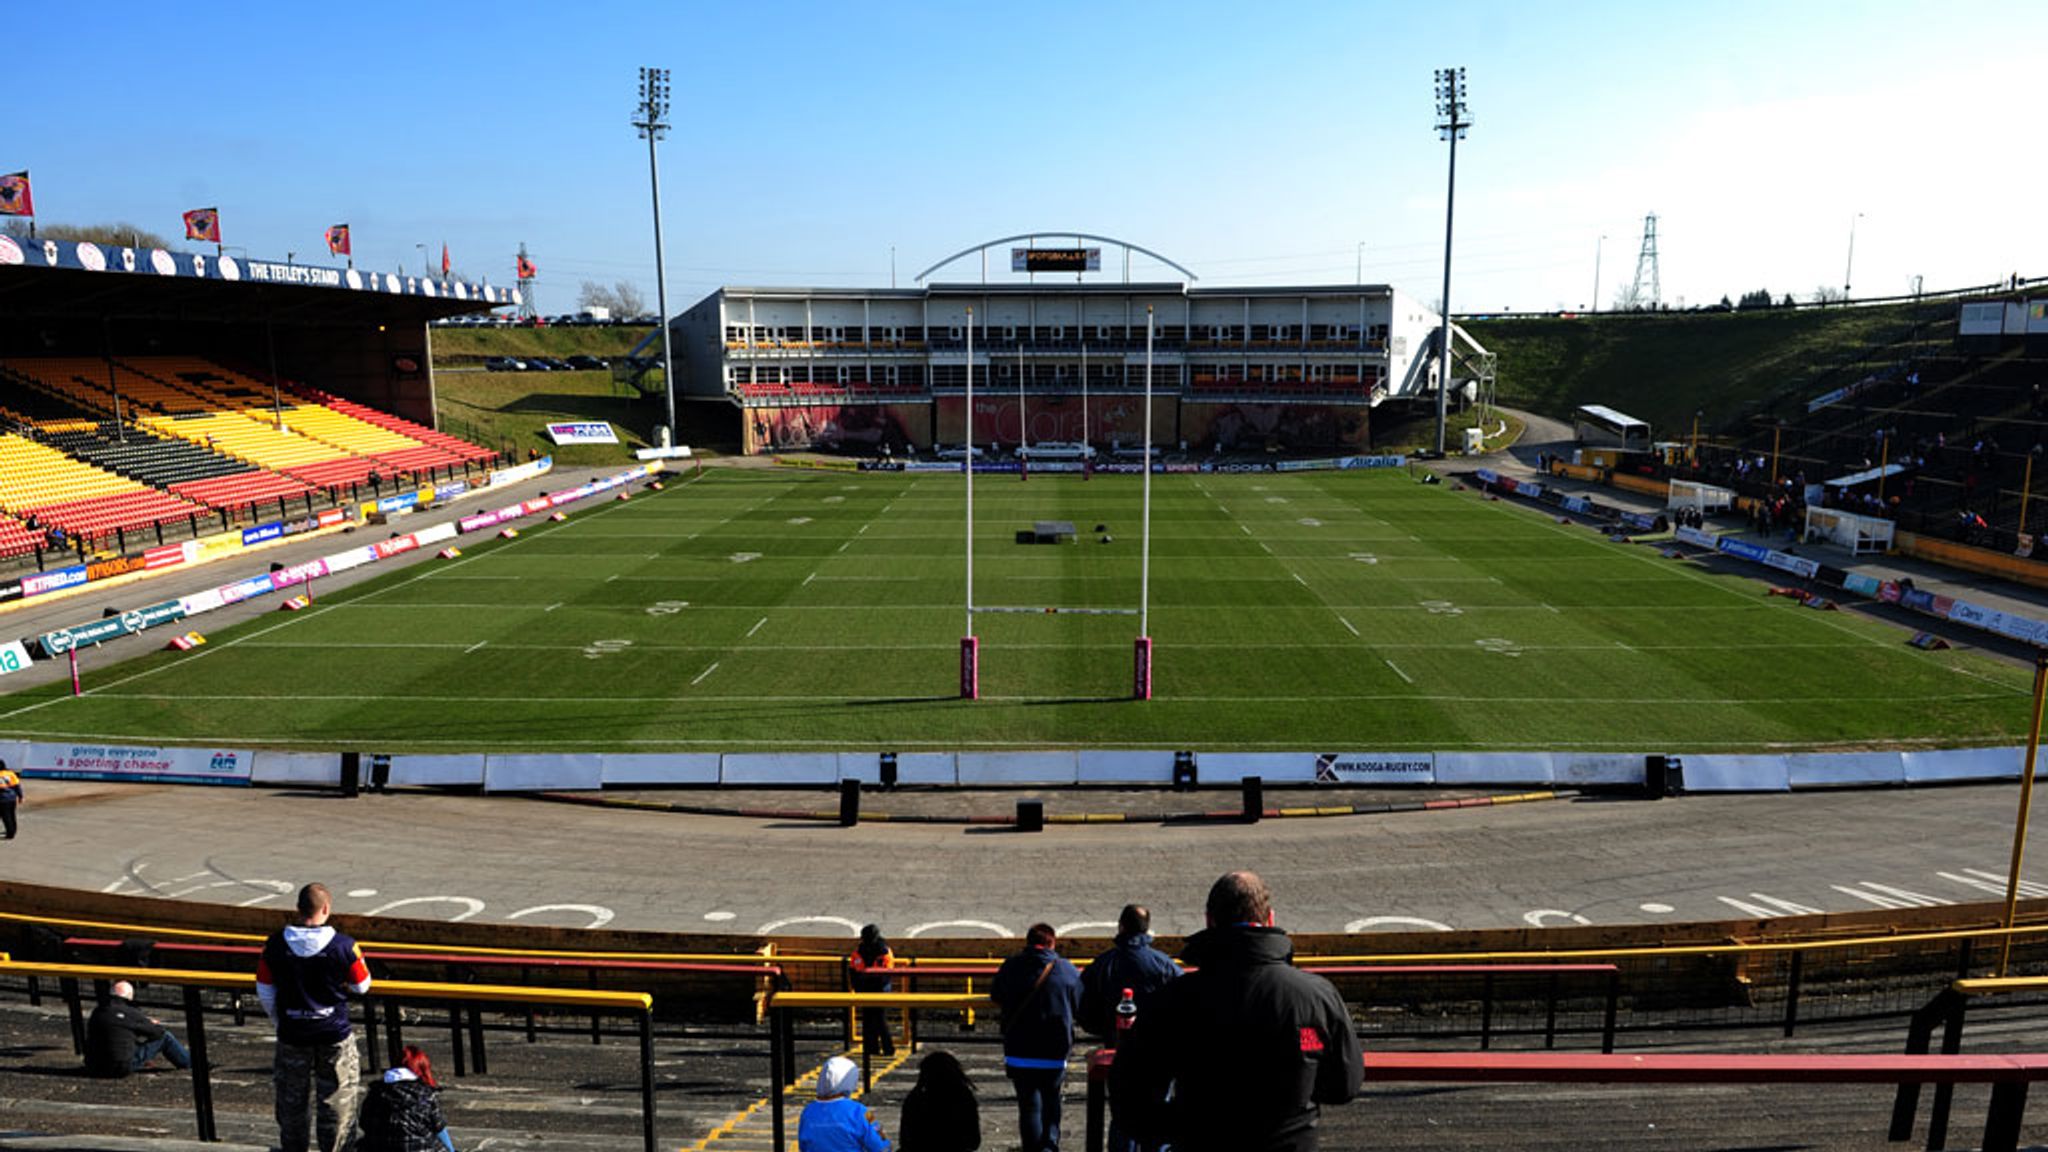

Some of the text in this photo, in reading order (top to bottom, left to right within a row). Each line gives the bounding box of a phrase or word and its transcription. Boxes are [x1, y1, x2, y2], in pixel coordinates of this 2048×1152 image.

[248, 262, 339, 285] THE TETLEY'S STAND
[976, 402, 998, 414] the
[1348, 457, 1399, 469] Alitalia
[72, 746, 158, 758] giving everyone
[68, 757, 121, 772] sporting
